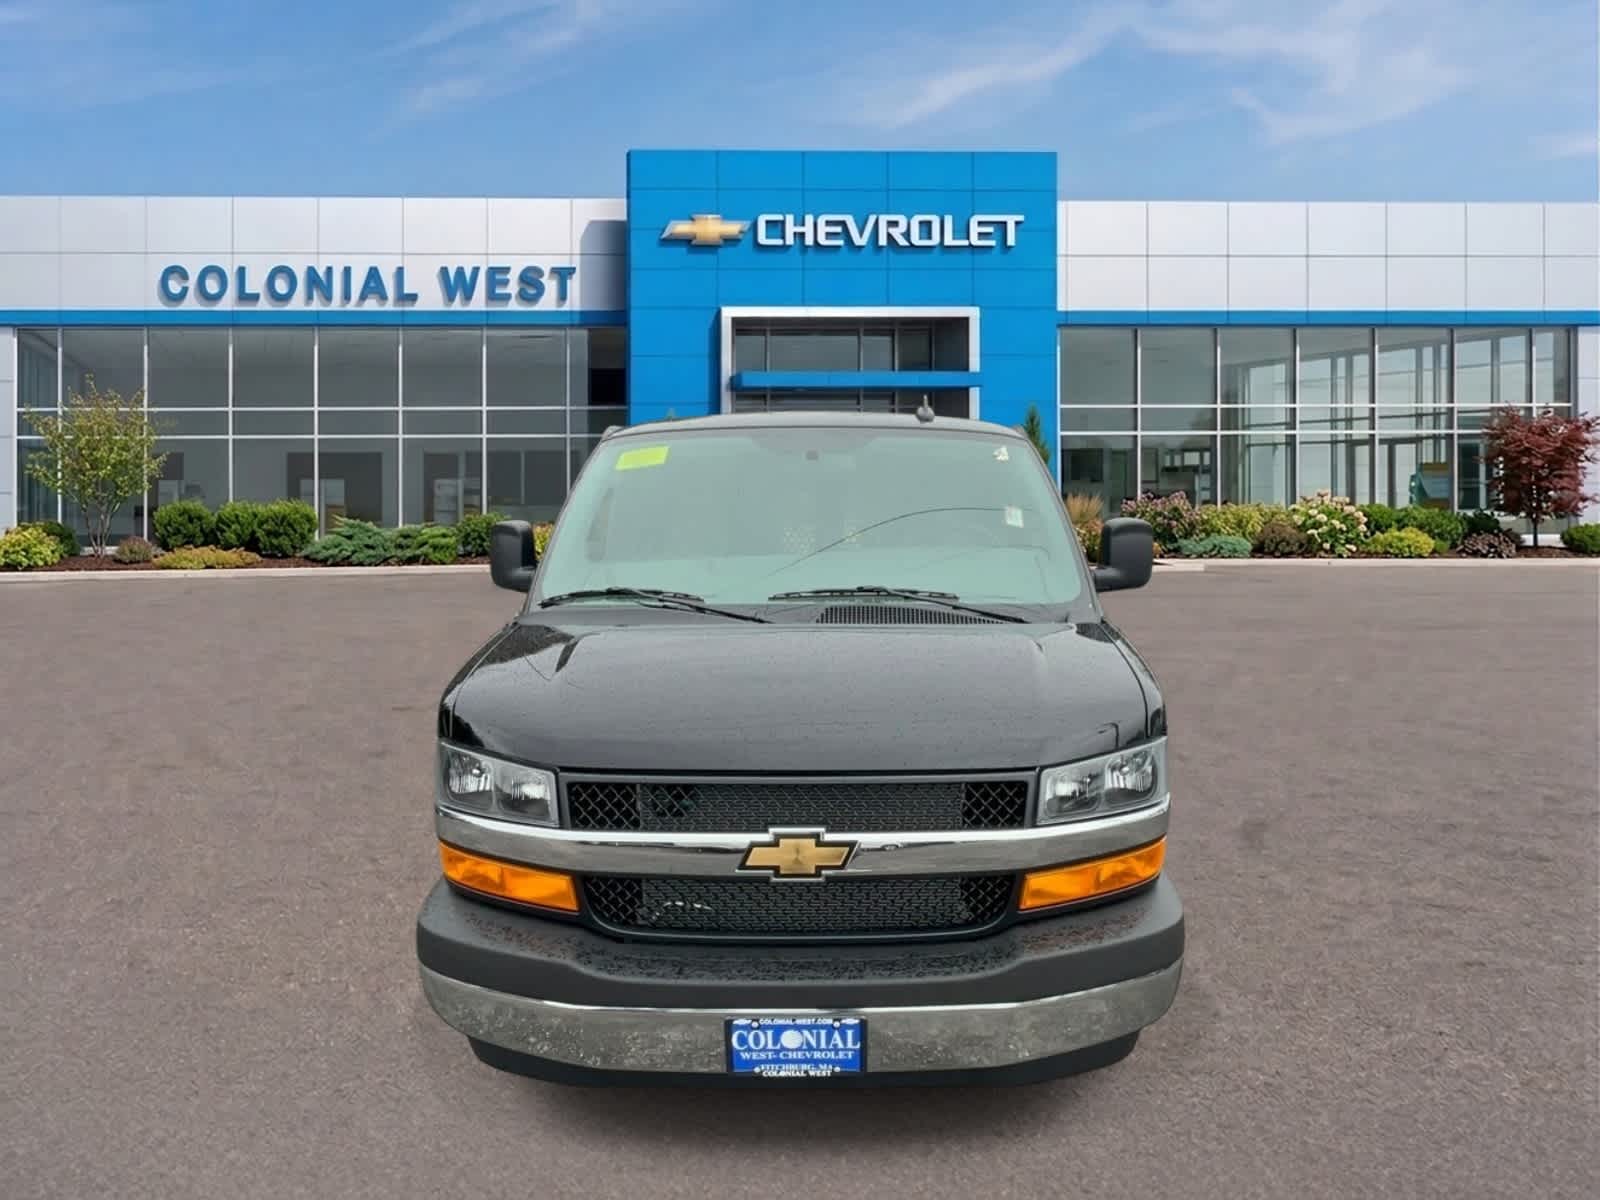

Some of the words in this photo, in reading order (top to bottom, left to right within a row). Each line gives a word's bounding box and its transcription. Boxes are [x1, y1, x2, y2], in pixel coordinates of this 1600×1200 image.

[756, 213, 1024, 247] CHEVROLET
[160, 264, 418, 302] COLONIAL
[440, 265, 576, 302] WEST
[731, 1029, 861, 1050] COLONIAL
[779, 1051, 855, 1060] CHEVROLET
